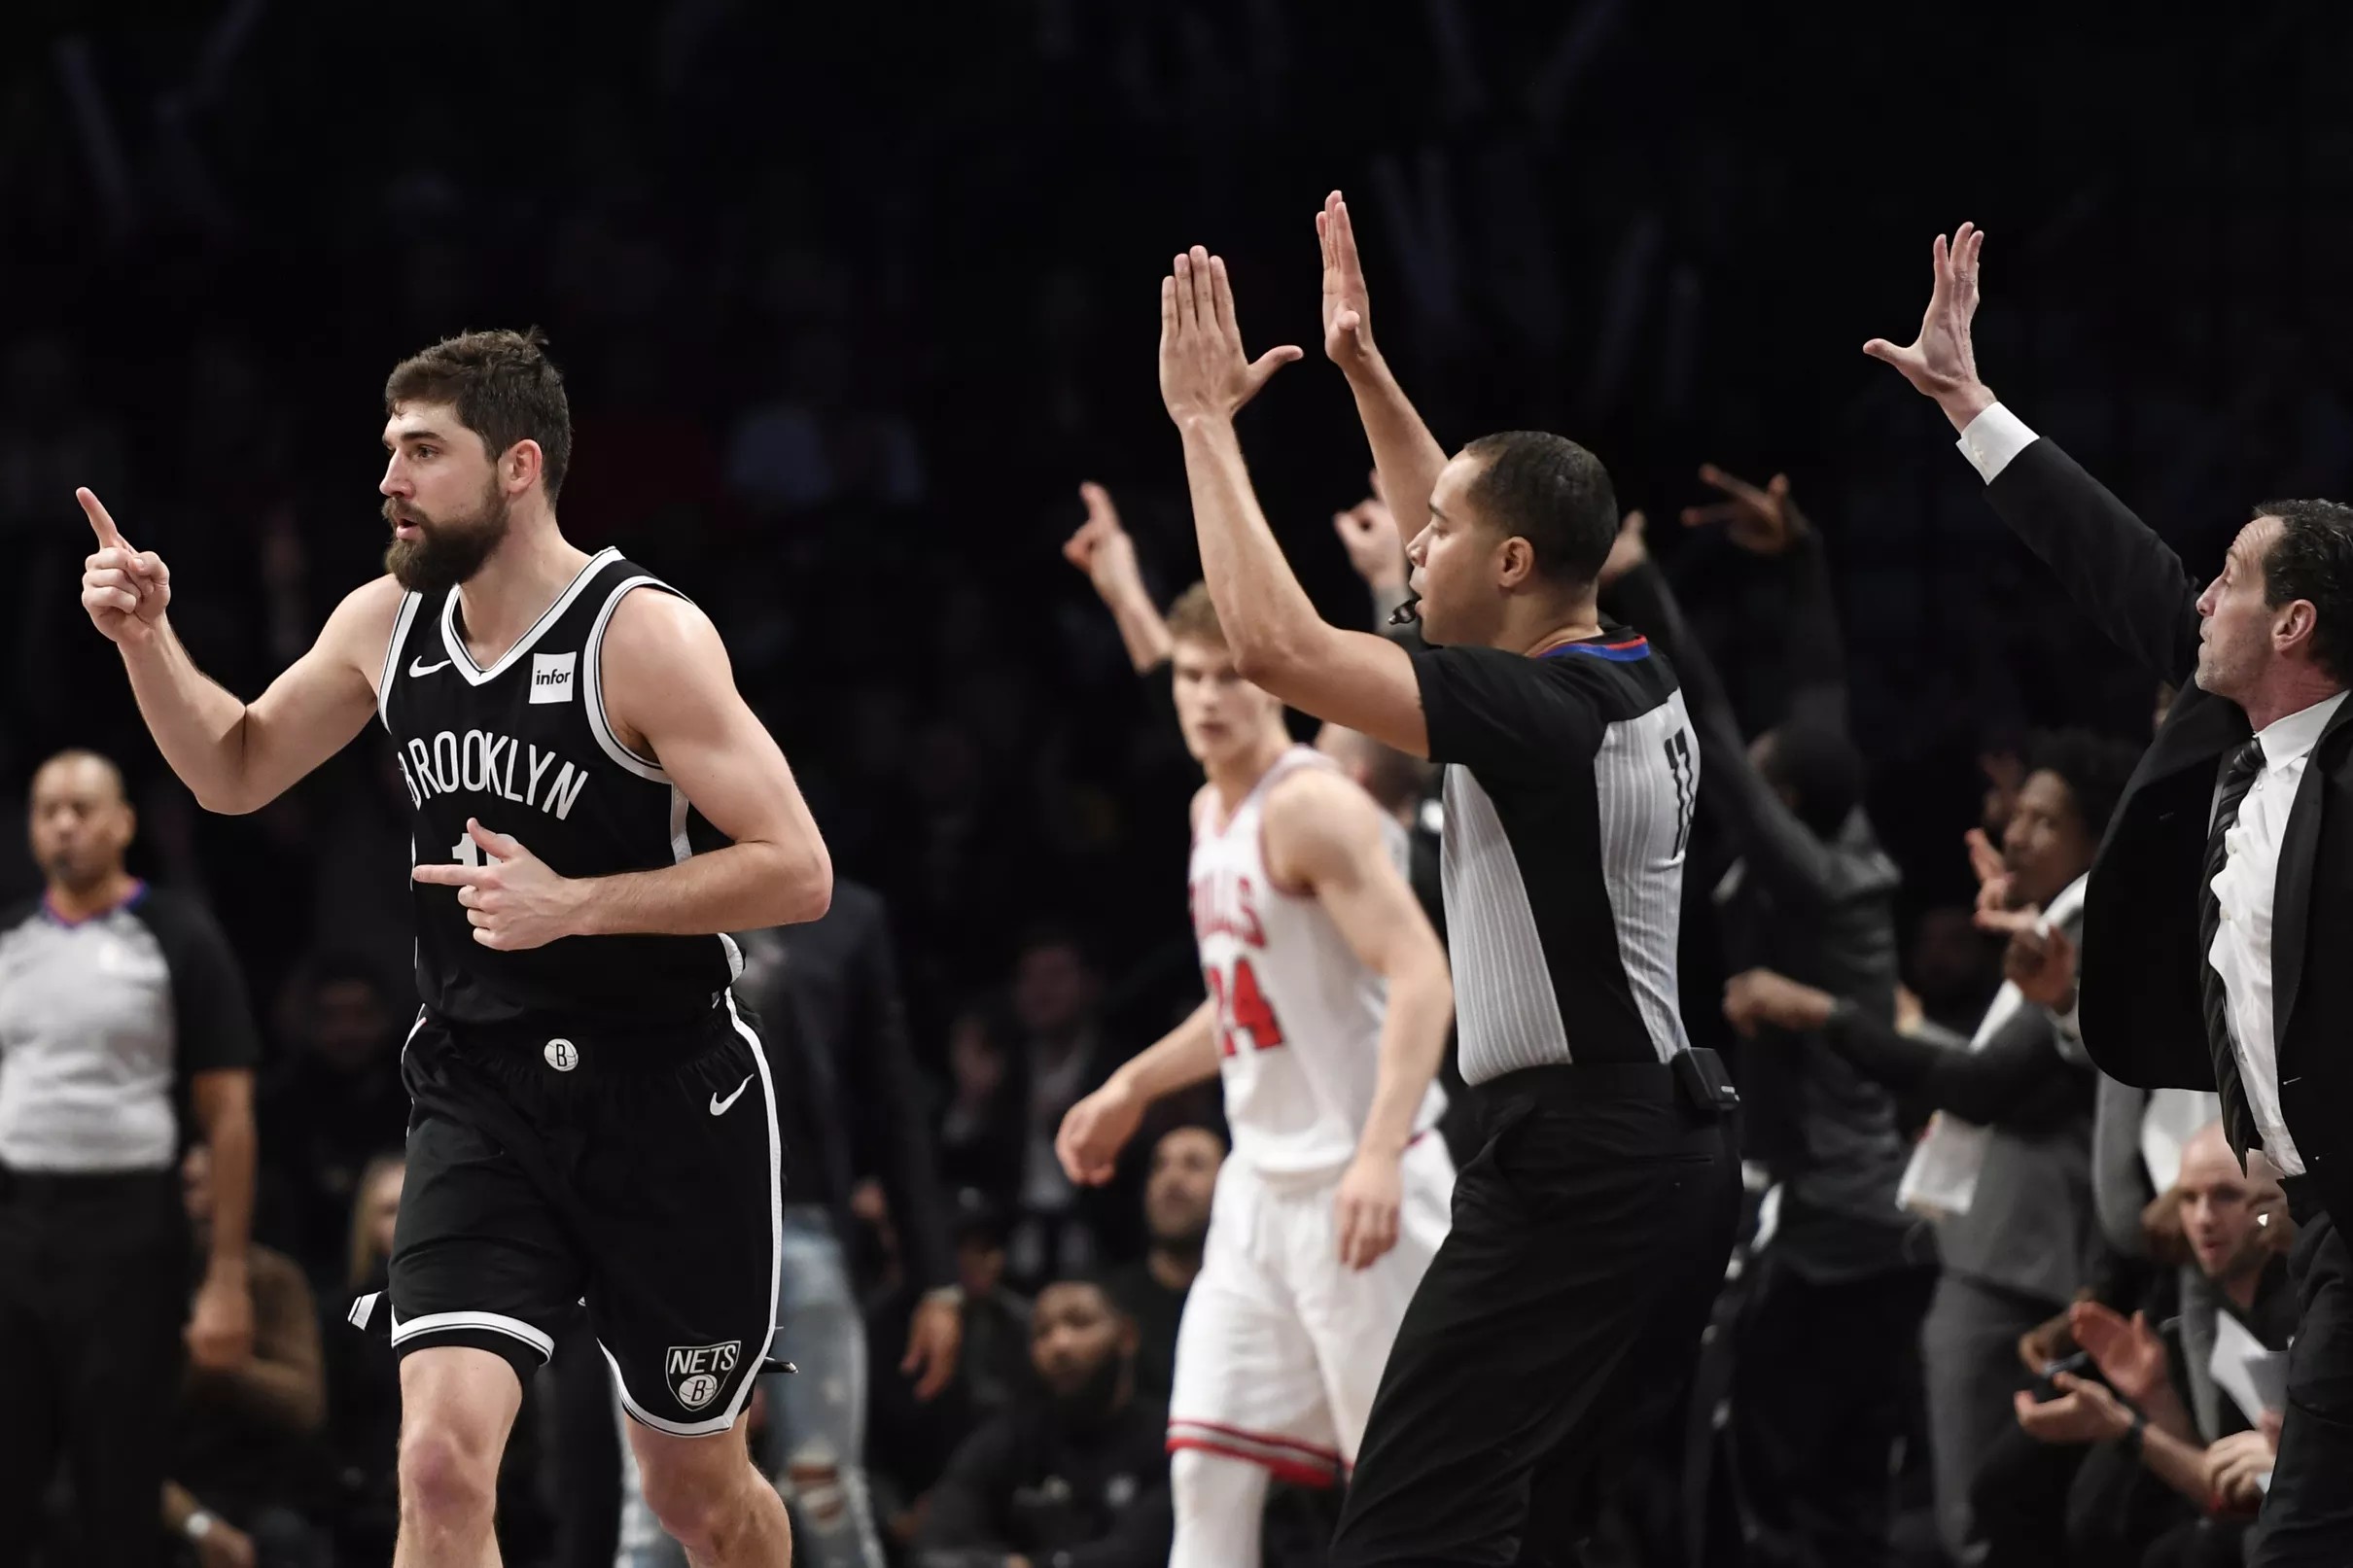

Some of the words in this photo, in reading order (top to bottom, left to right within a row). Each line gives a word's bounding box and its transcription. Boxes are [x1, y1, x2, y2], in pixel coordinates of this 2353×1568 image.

[536, 668, 572, 685] infor
[555, 1043, 568, 1067] B
[669, 1343, 737, 1375] NETS
[690, 1379, 707, 1402] B
